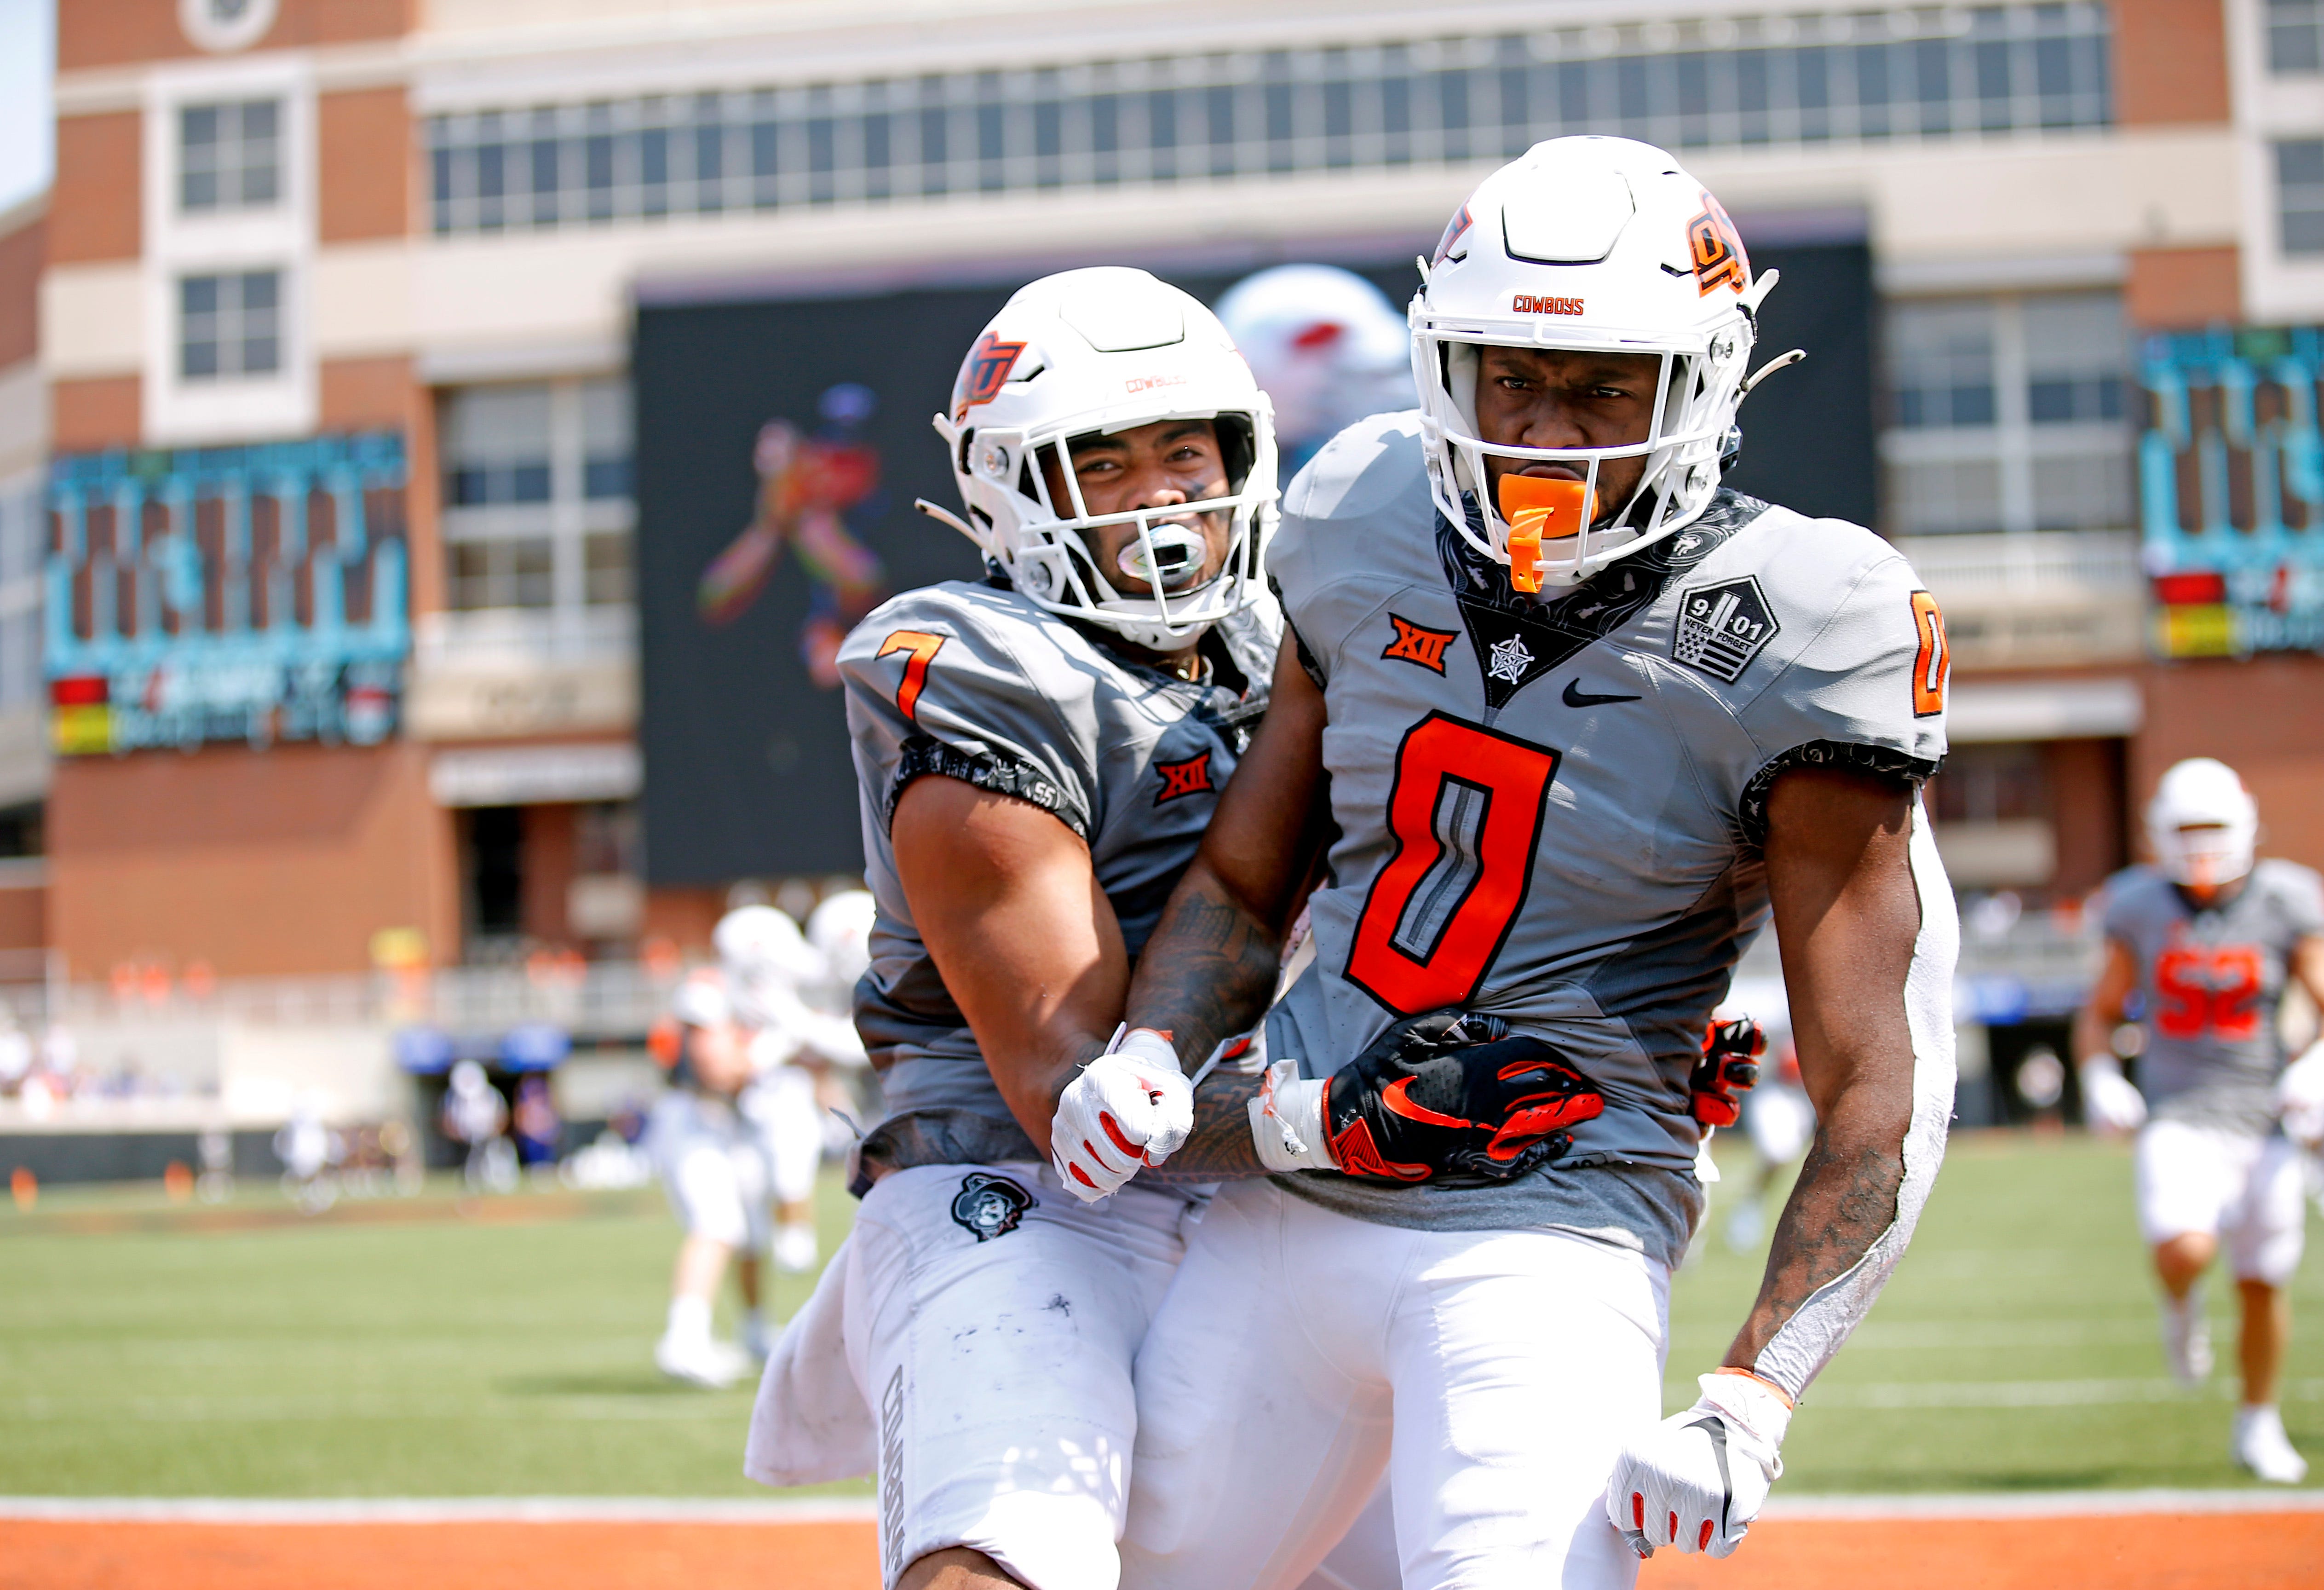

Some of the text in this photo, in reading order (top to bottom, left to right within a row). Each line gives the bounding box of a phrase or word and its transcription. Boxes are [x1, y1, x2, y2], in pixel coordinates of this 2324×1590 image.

[1513, 295, 1584, 316] COWBOYS
[1381, 612, 1460, 677] XII
[1685, 618, 1753, 652] NEVER FORGET
[1910, 590, 1950, 719] 0
[874, 630, 946, 721] 7
[1154, 748, 1215, 805] XII
[1342, 709, 1562, 1020] 0
